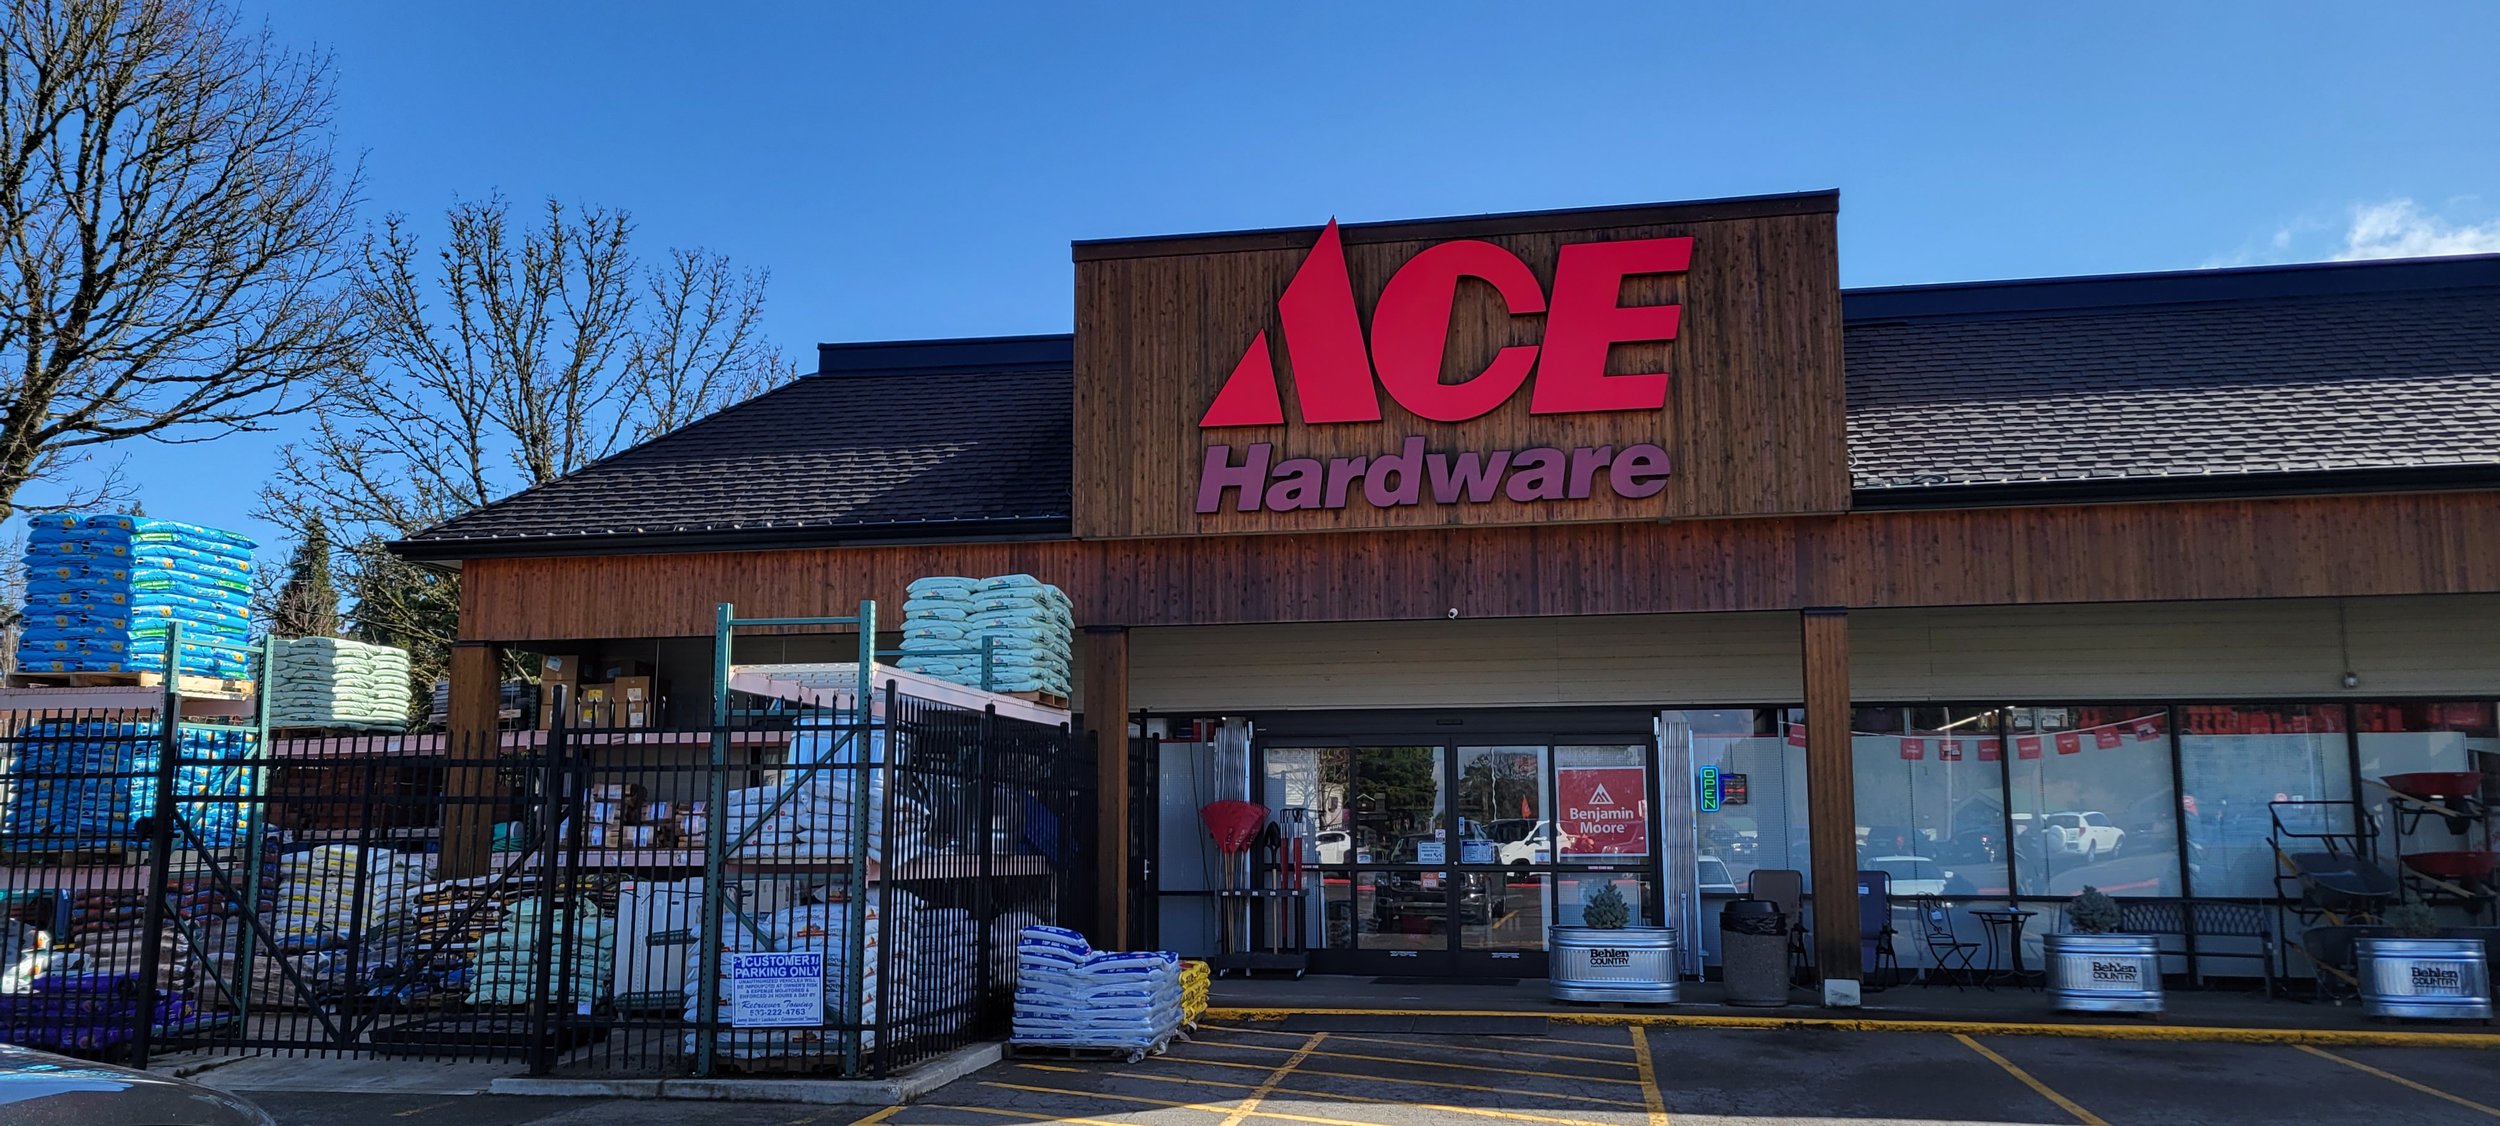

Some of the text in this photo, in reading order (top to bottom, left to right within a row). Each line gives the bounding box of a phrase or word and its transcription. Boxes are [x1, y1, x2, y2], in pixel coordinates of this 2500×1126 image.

[1198, 215, 1694, 427] ACE
[1195, 435, 1672, 514] Hardware
[1703, 769, 1716, 809] OPEN
[1569, 807, 1634, 822] Benjamin
[1580, 821, 1625, 834] Moore
[1590, 949, 1629, 957] Behlen
[746, 956, 810, 967] CUSTOMER
[2093, 962, 2136, 972] Behlen
[735, 966, 819, 978] PARKING ONLY
[2093, 972, 2136, 980] COUNTRY
[2411, 967, 2458, 978] Behlen
[2412, 977, 2458, 985] COUNTRY
[741, 999, 814, 1010] Retriever Towing
